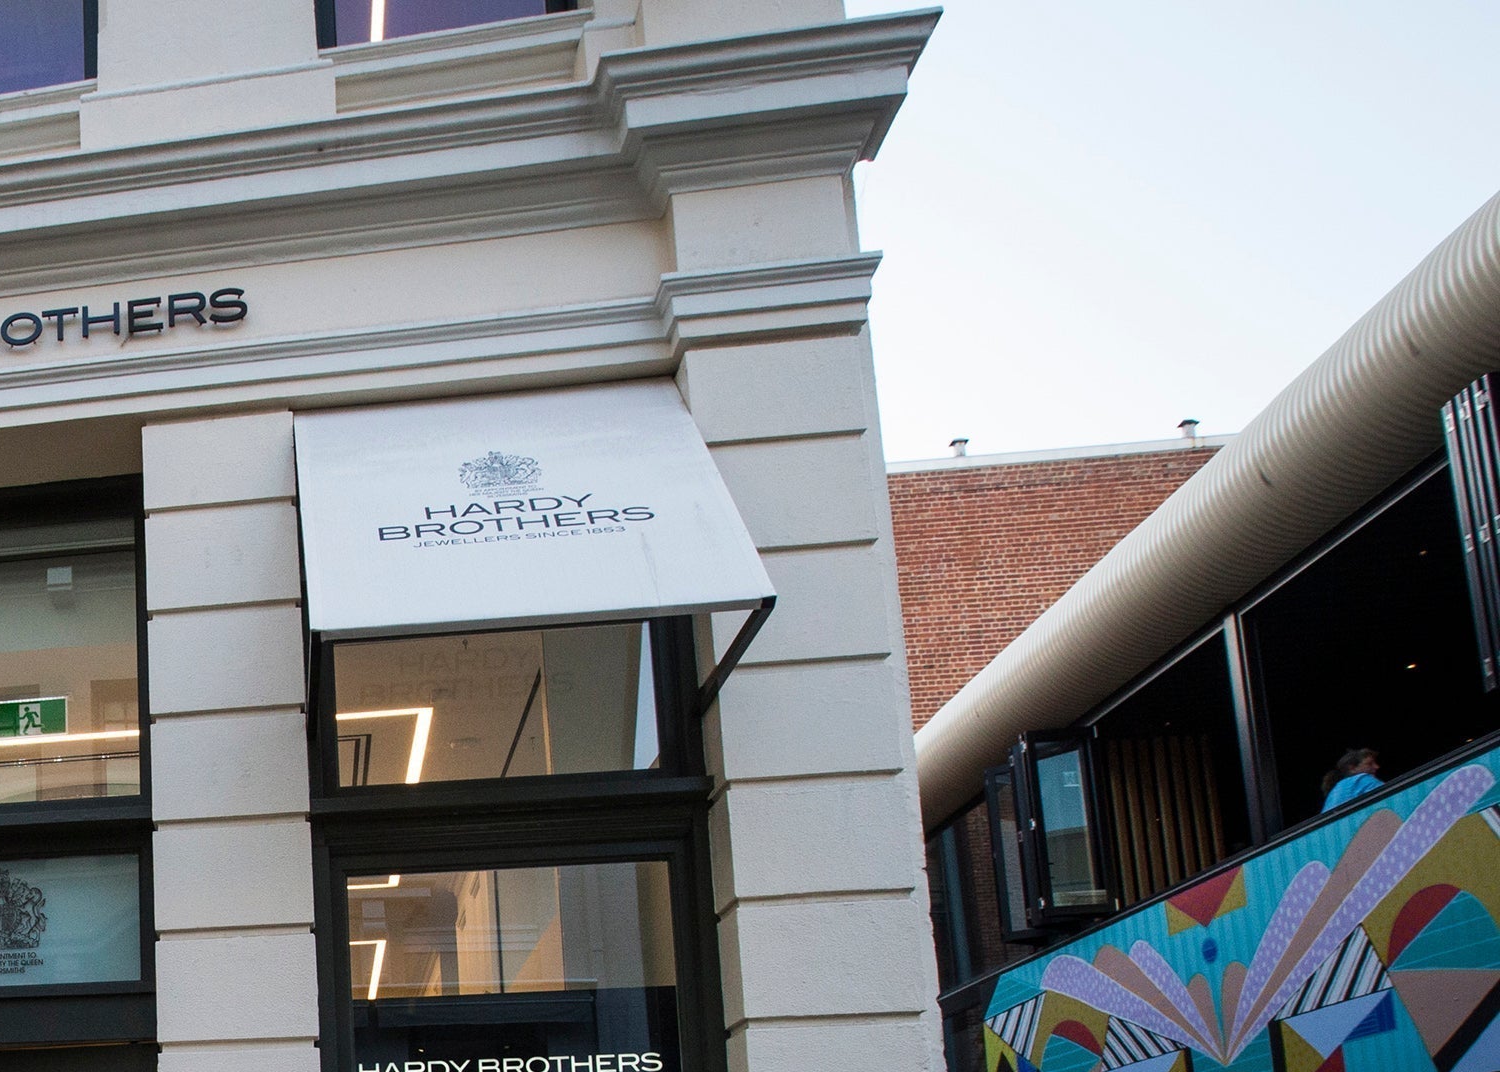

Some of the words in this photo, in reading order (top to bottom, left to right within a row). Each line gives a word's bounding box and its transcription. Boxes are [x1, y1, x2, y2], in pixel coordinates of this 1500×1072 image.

[425, 493, 593, 520] HARDY
[378, 506, 655, 541] BROTHERS
[413, 533, 521, 547] JEWELLERS
[525, 529, 582, 539] SINCE
[586, 525, 626, 535] 1853
[8, 959, 19, 967] THE
